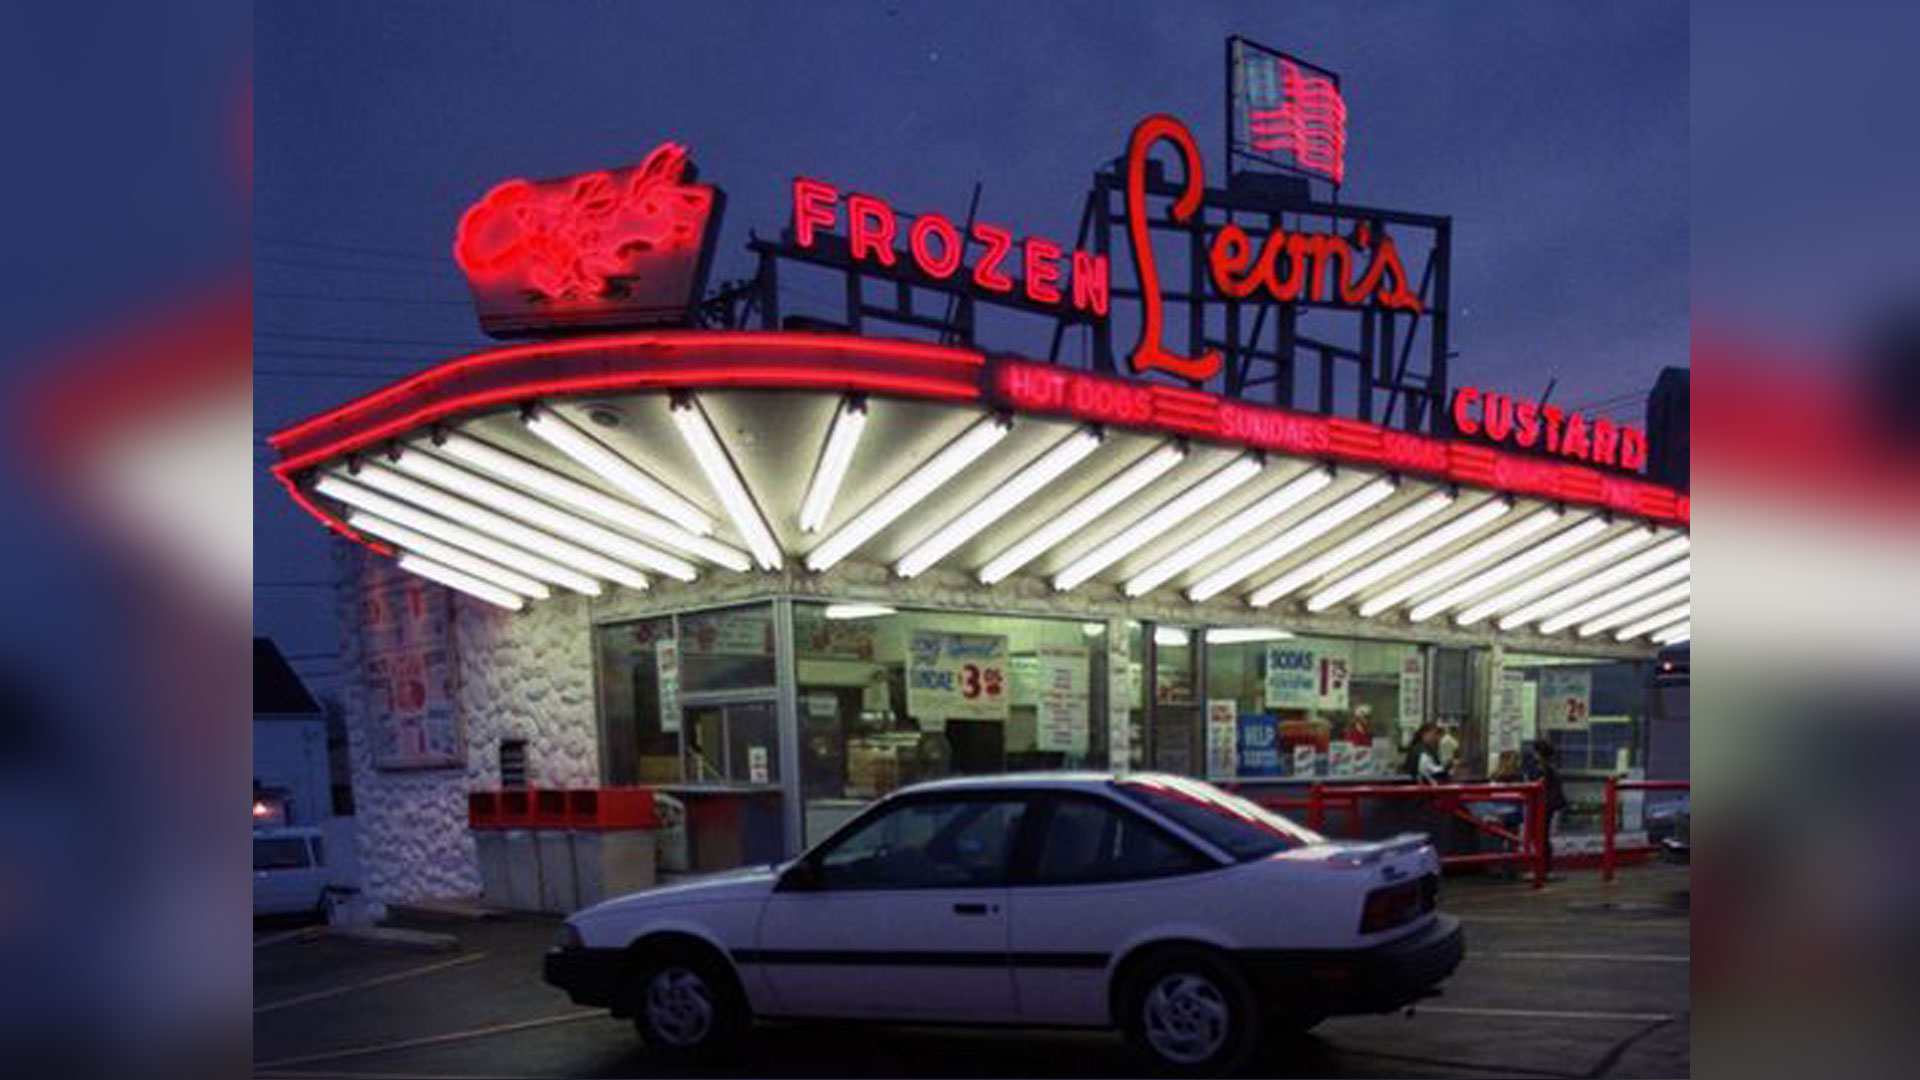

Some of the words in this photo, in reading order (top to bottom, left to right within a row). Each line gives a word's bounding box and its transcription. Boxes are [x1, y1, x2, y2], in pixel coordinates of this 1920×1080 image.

[791, 175, 1109, 317] FROZEN
[1126, 113, 1422, 379] Leon's
[1006, 364, 1066, 405] HOT
[1070, 378, 1151, 420] DOGS
[1219, 404, 1329, 451] SUNDAES
[1453, 386, 1648, 470] CUSTARD
